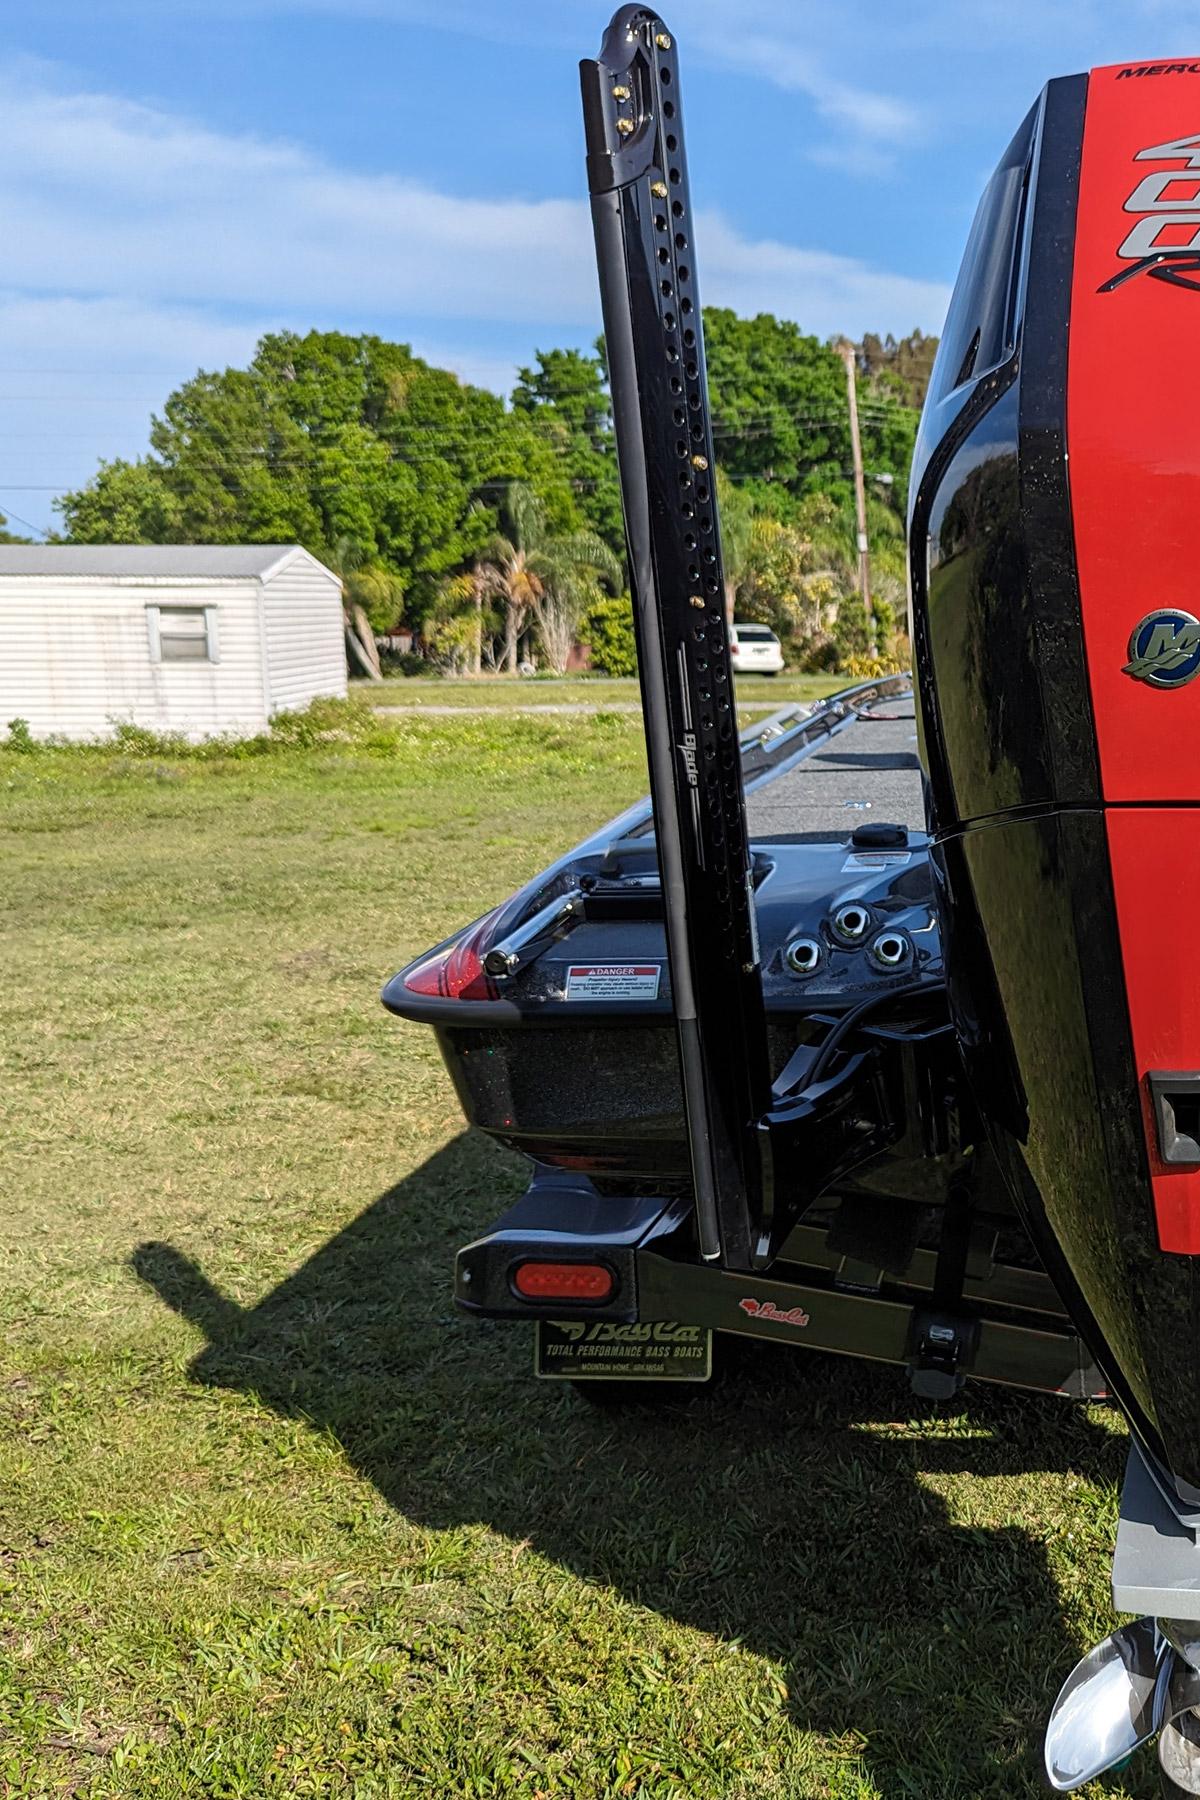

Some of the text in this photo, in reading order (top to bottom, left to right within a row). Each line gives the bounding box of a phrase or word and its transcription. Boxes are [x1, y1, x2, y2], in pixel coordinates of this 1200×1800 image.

[677, 732, 699, 786] Blade
[596, 967, 635, 976] DANGER
[546, 1344, 704, 1358] TOTAL PERFORMANCE BASS BOATS
